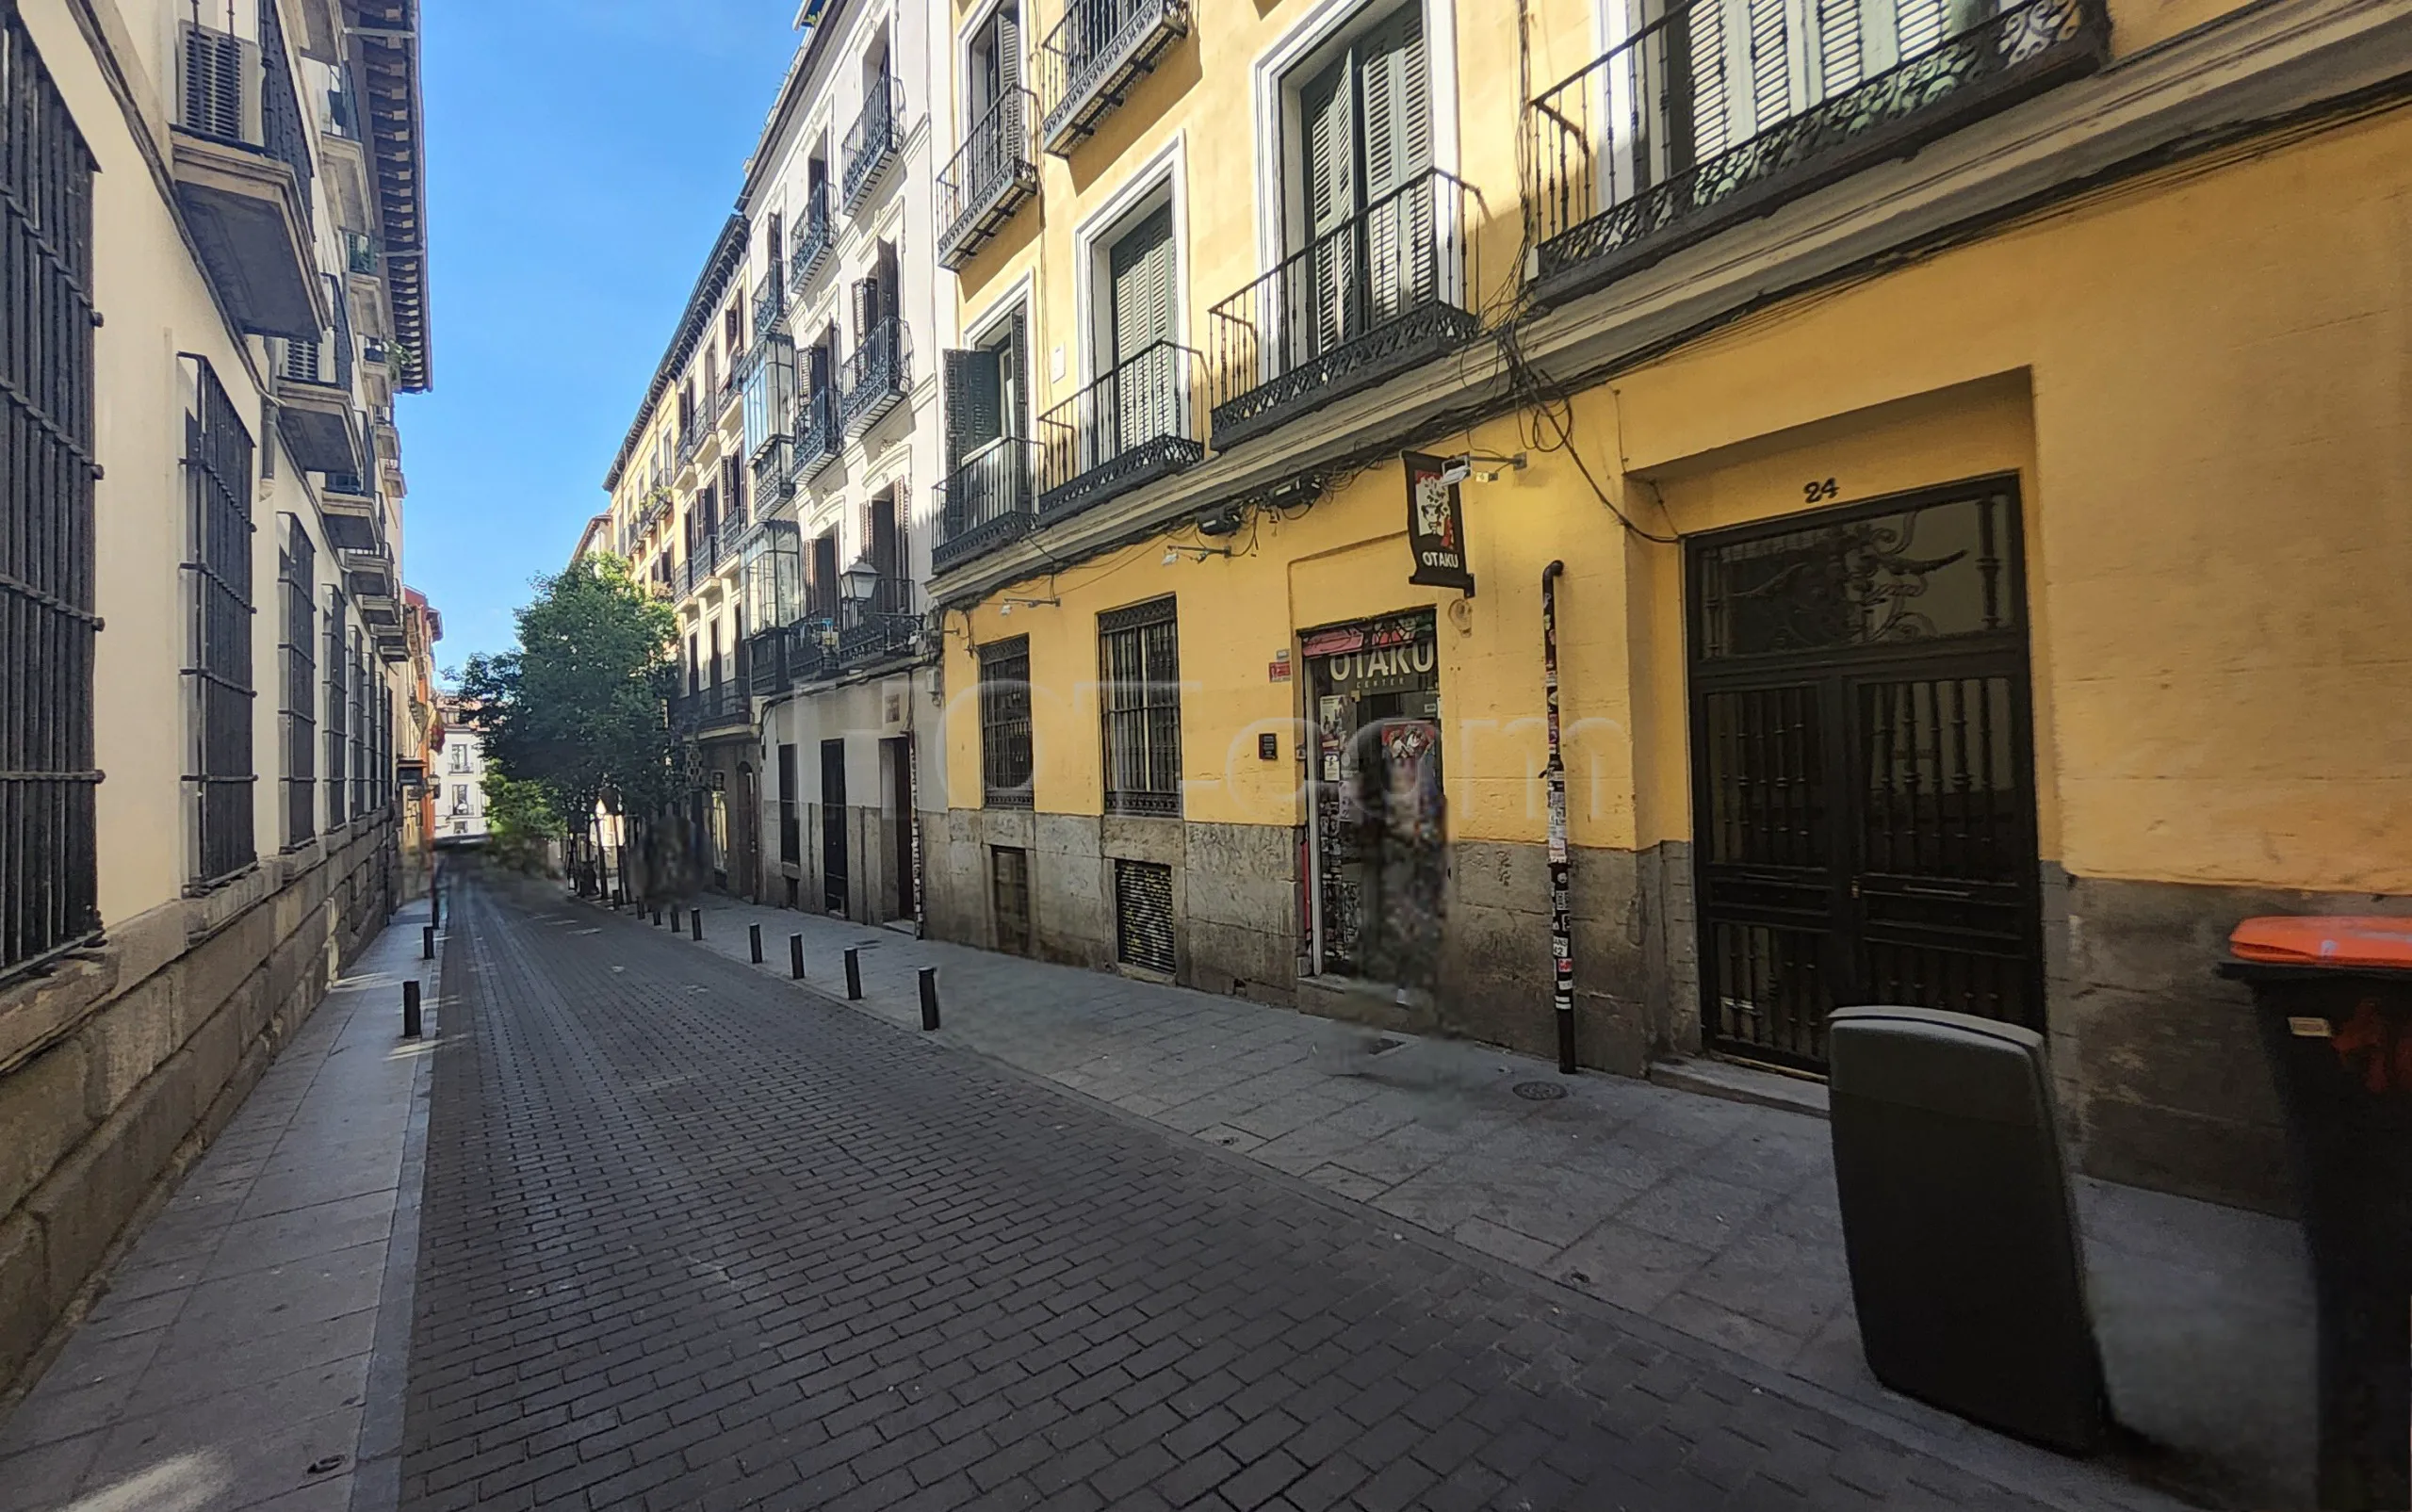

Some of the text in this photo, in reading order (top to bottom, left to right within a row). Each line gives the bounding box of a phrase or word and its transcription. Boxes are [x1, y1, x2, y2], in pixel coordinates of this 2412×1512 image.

[1802, 477, 1840, 504] 24
[1422, 551, 1459, 568] OTAKU
[1329, 642, 1435, 681] OTAKU
[1356, 677, 1406, 689] CENTER
